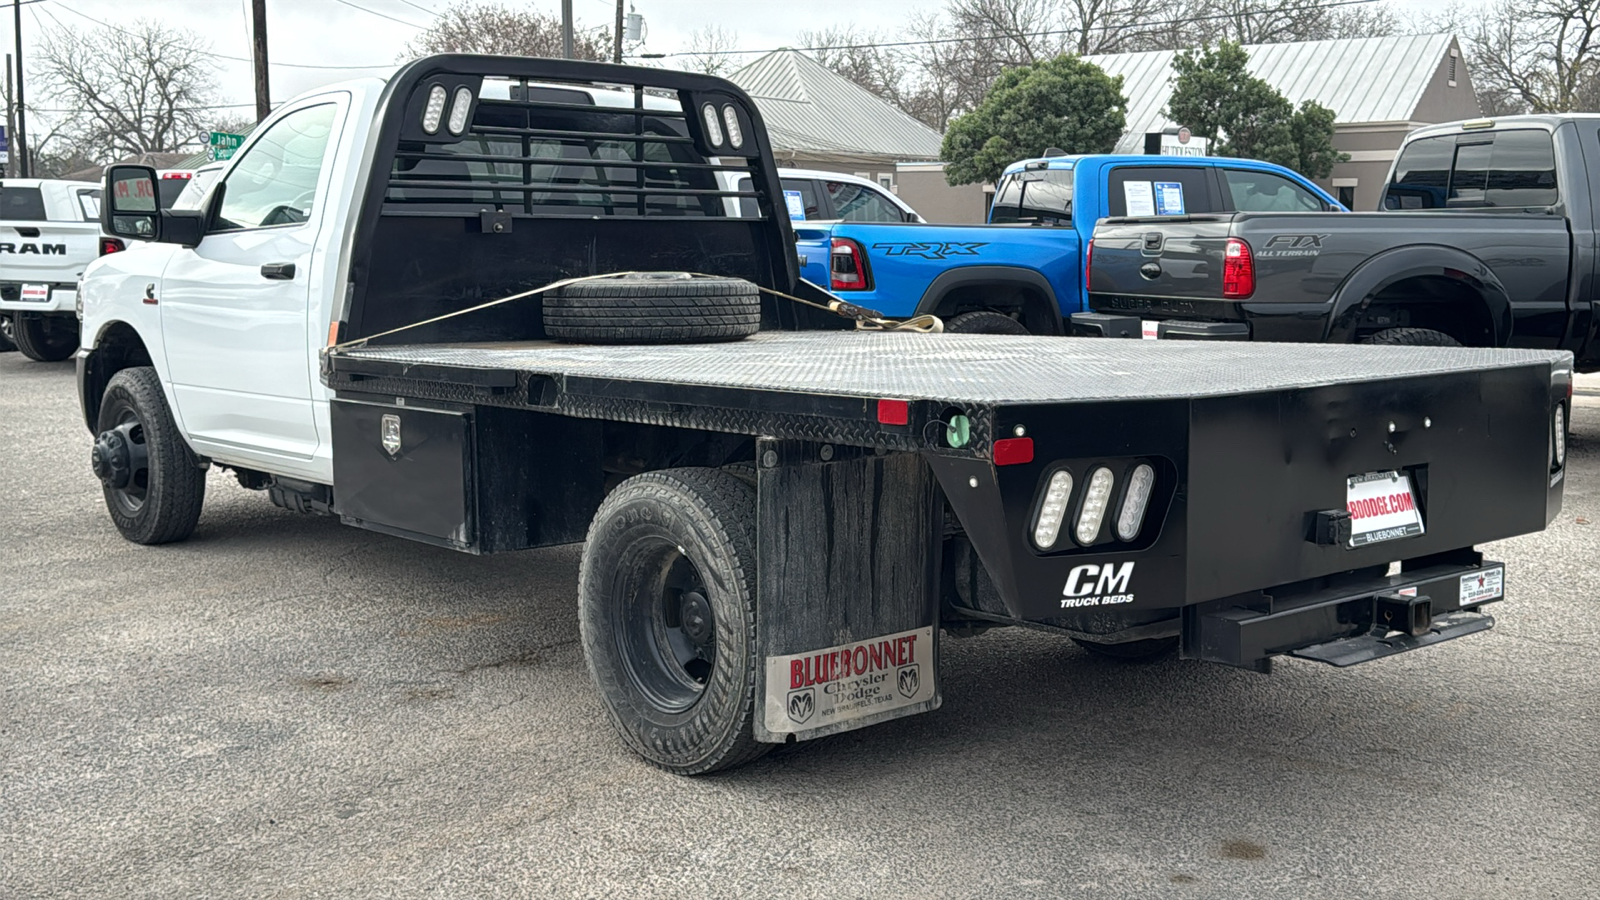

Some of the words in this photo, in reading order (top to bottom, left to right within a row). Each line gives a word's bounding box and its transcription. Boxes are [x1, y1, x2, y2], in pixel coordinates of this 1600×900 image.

[217, 134, 238, 148] Jahn
[0, 242, 67, 255] RAM
[872, 242, 991, 260] TRX
[1275, 249, 1321, 257] TERRAIN
[1346, 492, 1414, 520] BDODGE.COM
[1366, 526, 1407, 542] BLUEBONNET
[1062, 561, 1136, 597] CM
[1060, 596, 1101, 609] TRUCK
[1101, 594, 1135, 605] BEDS
[789, 635, 917, 689] BLUEBONNET
[823, 672, 889, 695] Chrysler
[833, 685, 881, 705] Dodge
[821, 707, 836, 717] NEW
[874, 693, 893, 704] TEXAS
